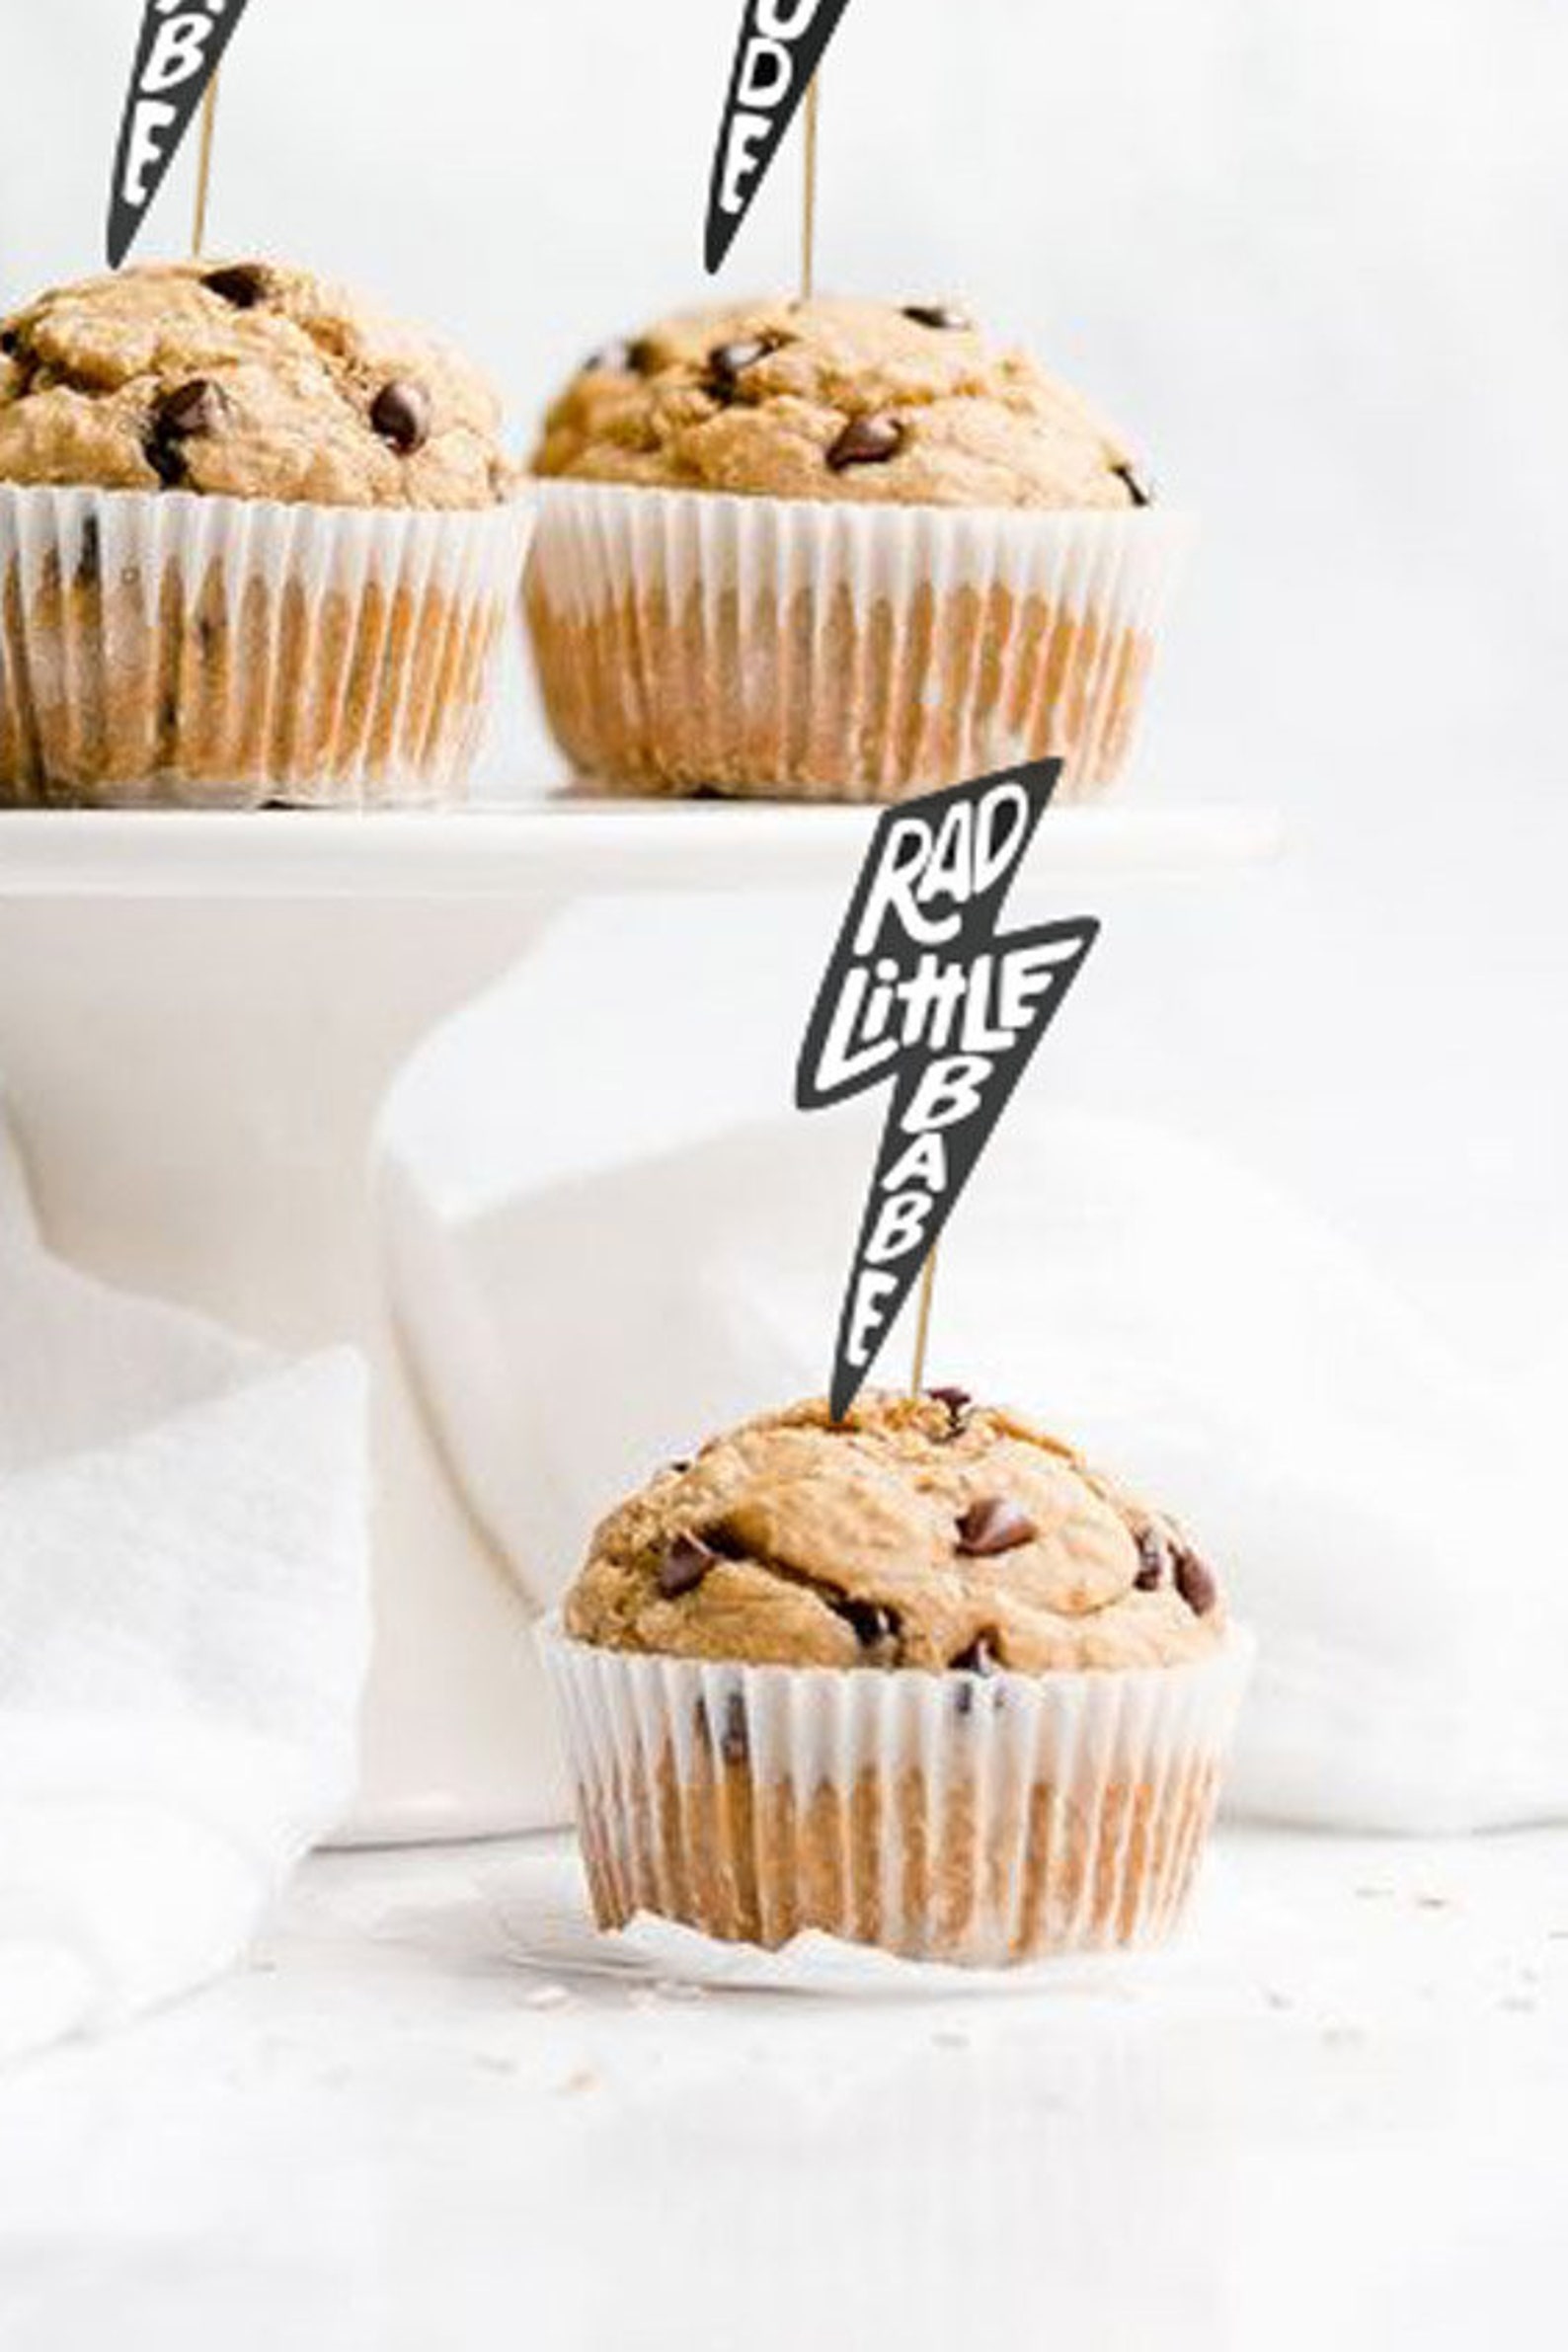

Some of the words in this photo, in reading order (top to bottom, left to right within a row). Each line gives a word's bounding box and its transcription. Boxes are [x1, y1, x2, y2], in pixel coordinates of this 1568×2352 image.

[122, 0, 225, 206] BE
[853, 783, 1029, 956] RAD
[846, 1056, 993, 1367] BABE
